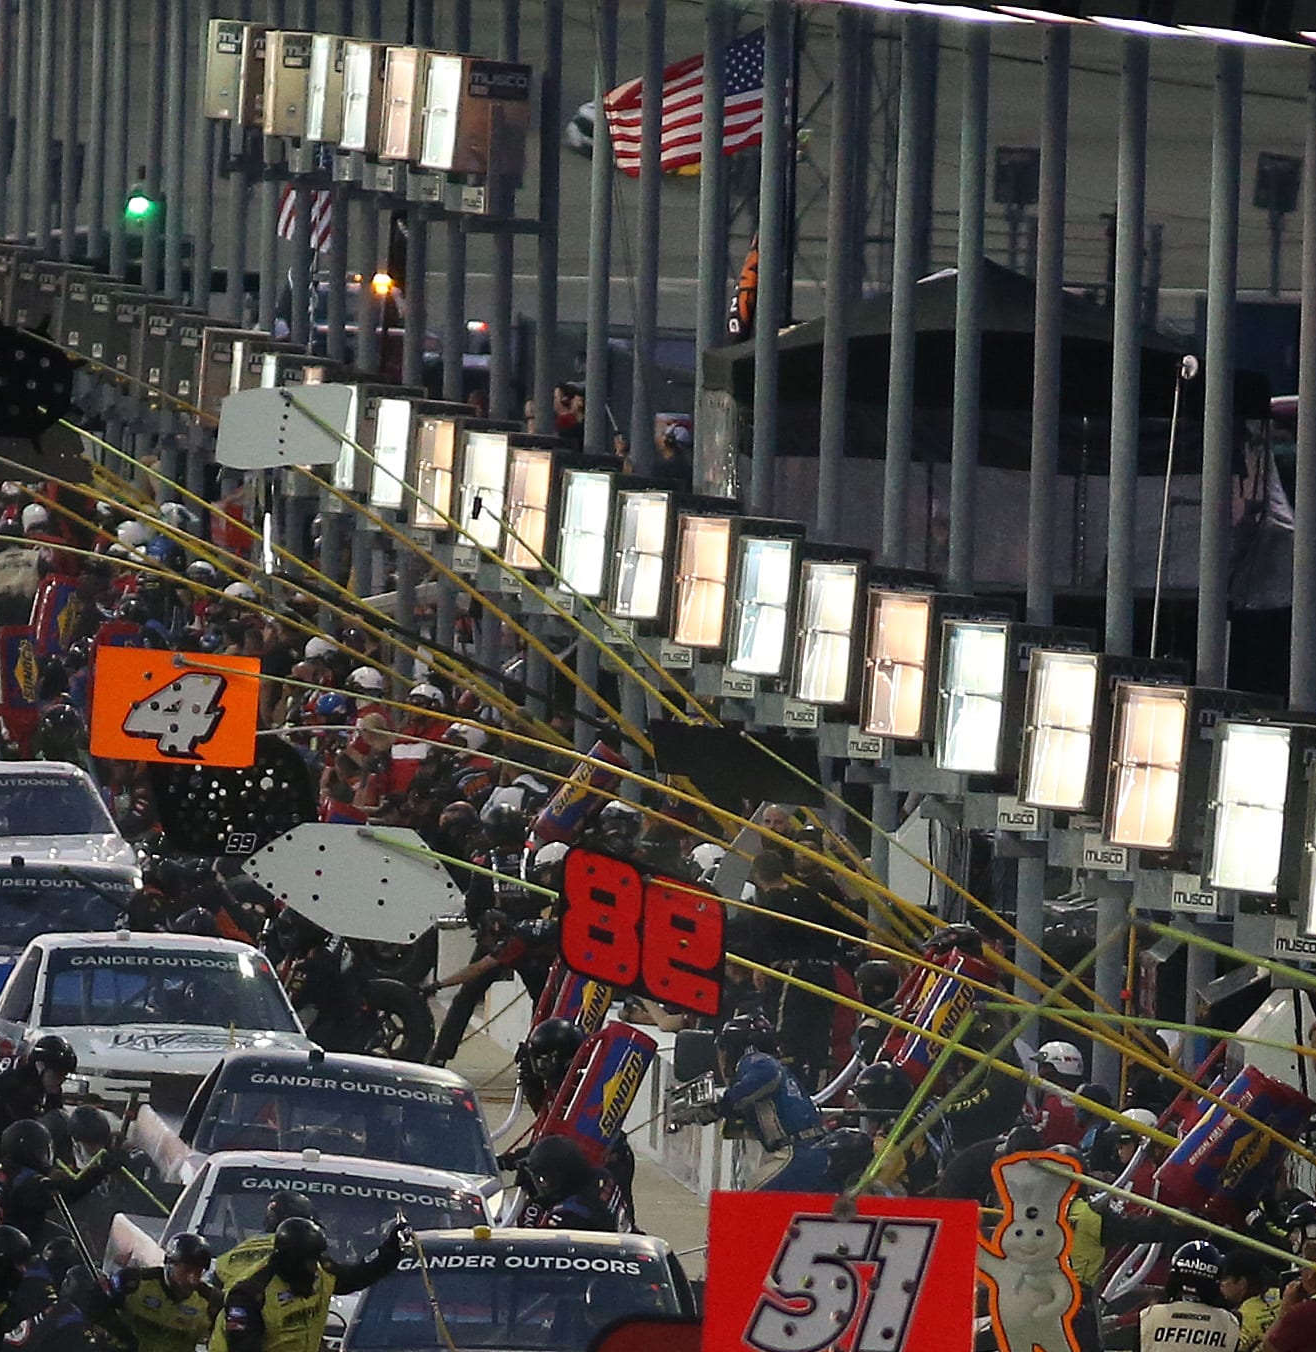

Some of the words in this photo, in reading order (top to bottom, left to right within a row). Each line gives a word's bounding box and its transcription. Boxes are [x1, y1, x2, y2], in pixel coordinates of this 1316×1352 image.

[122, 671, 228, 760] 4
[225, 833, 257, 854] 99
[70, 955, 148, 967] GANDER
[251, 1073, 337, 1090] GANDER
[341, 1081, 454, 1106] OUTDOORS
[600, 1051, 643, 1136] SUNOCO
[242, 1177, 336, 1194] GANDER
[340, 1185, 463, 1211] OUTDOORS
[397, 1254, 495, 1272] GANDER
[504, 1255, 642, 1276] OUTDOORS
[1175, 1258, 1219, 1274] GANDER
[1154, 1326, 1227, 1348] OFFICIAL
